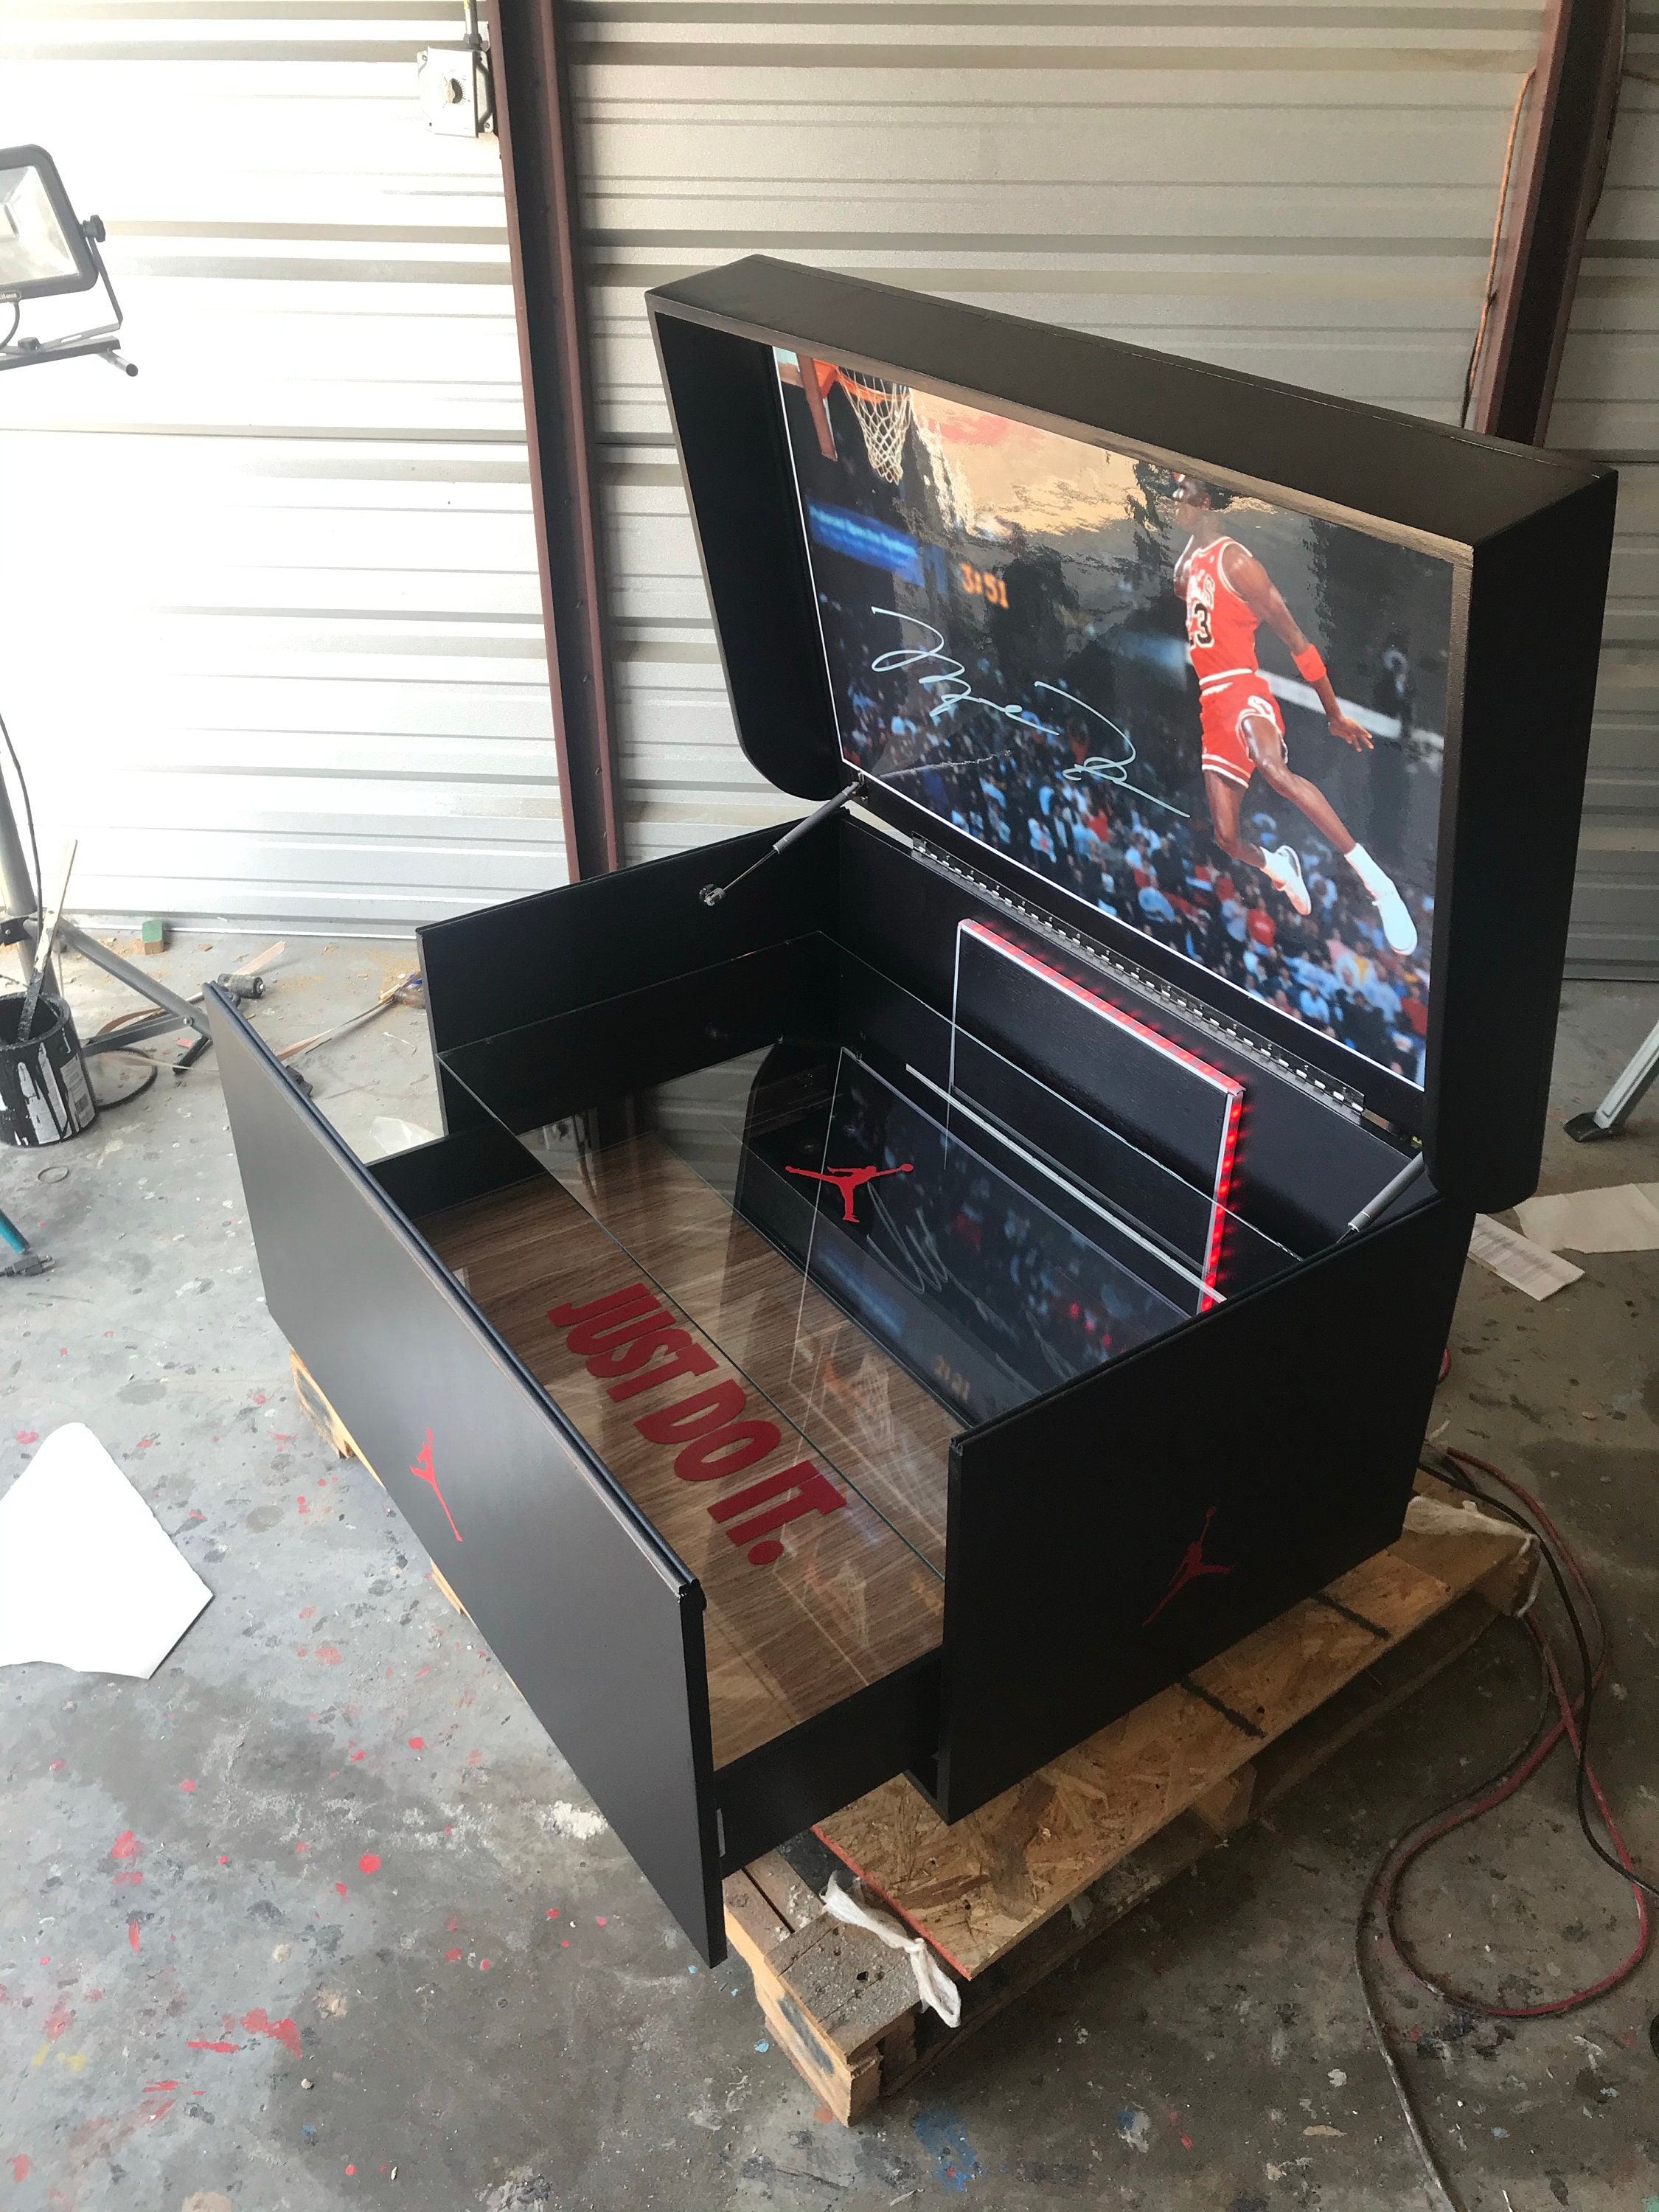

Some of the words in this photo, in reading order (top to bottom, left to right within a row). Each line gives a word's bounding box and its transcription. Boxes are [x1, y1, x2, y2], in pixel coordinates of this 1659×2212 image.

[1189, 599, 1215, 649] 3
[547, 1282, 719, 1402] JUST
[633, 1378, 782, 1481] DO
[707, 1460, 847, 1565] IT.
